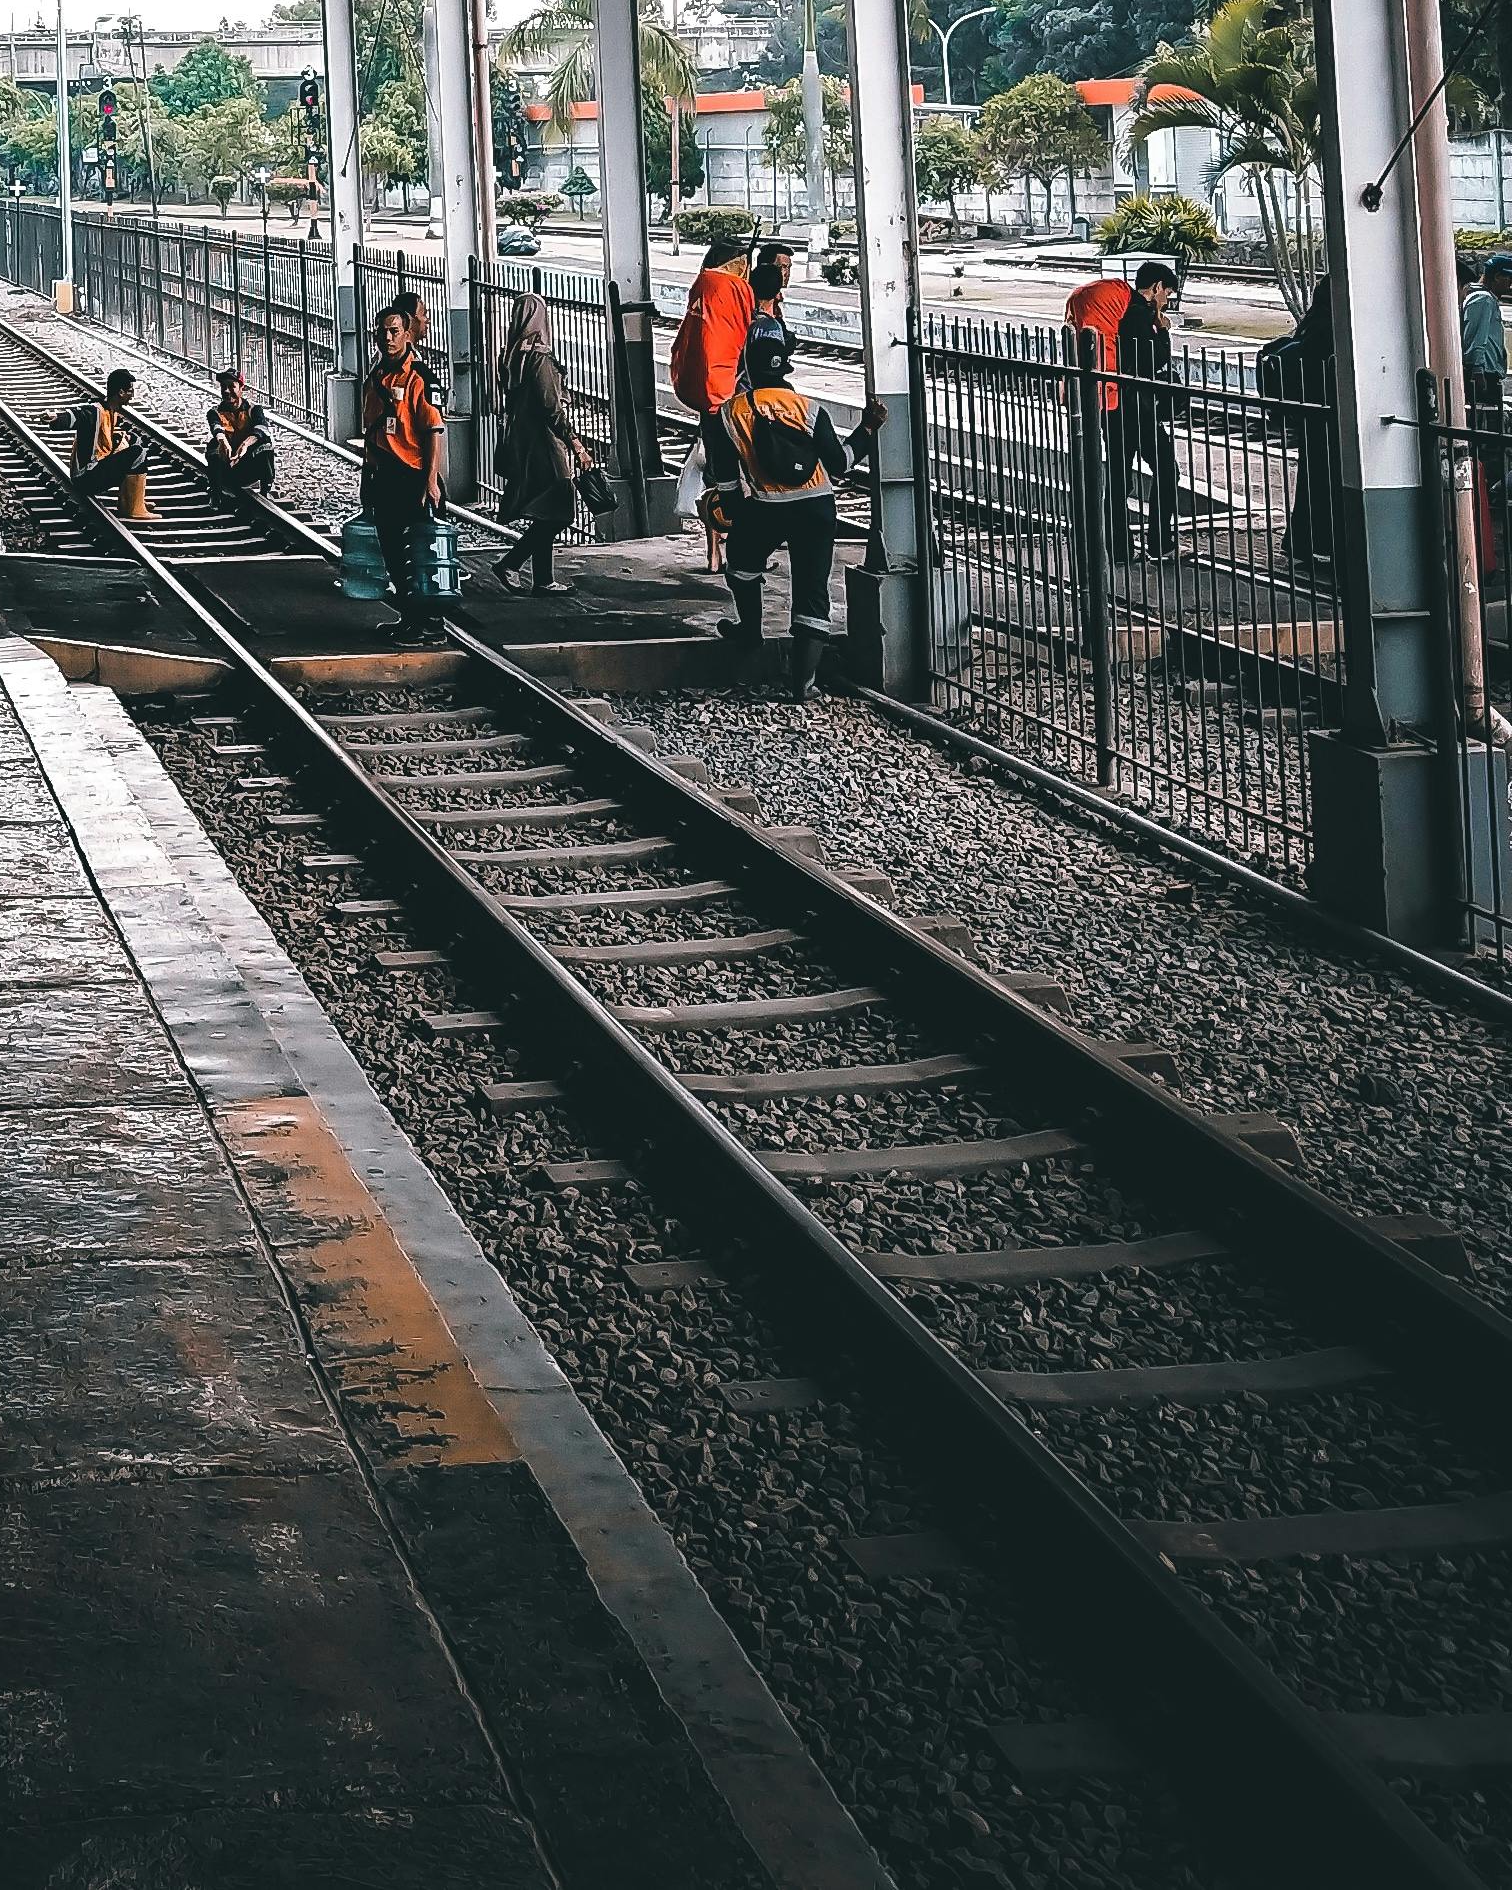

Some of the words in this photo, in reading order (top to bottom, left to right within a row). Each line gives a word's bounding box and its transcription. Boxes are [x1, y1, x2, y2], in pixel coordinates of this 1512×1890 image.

[303, 65, 315, 81] 3
[102, 76, 113, 90] 3
[508, 79, 517, 92] 3
